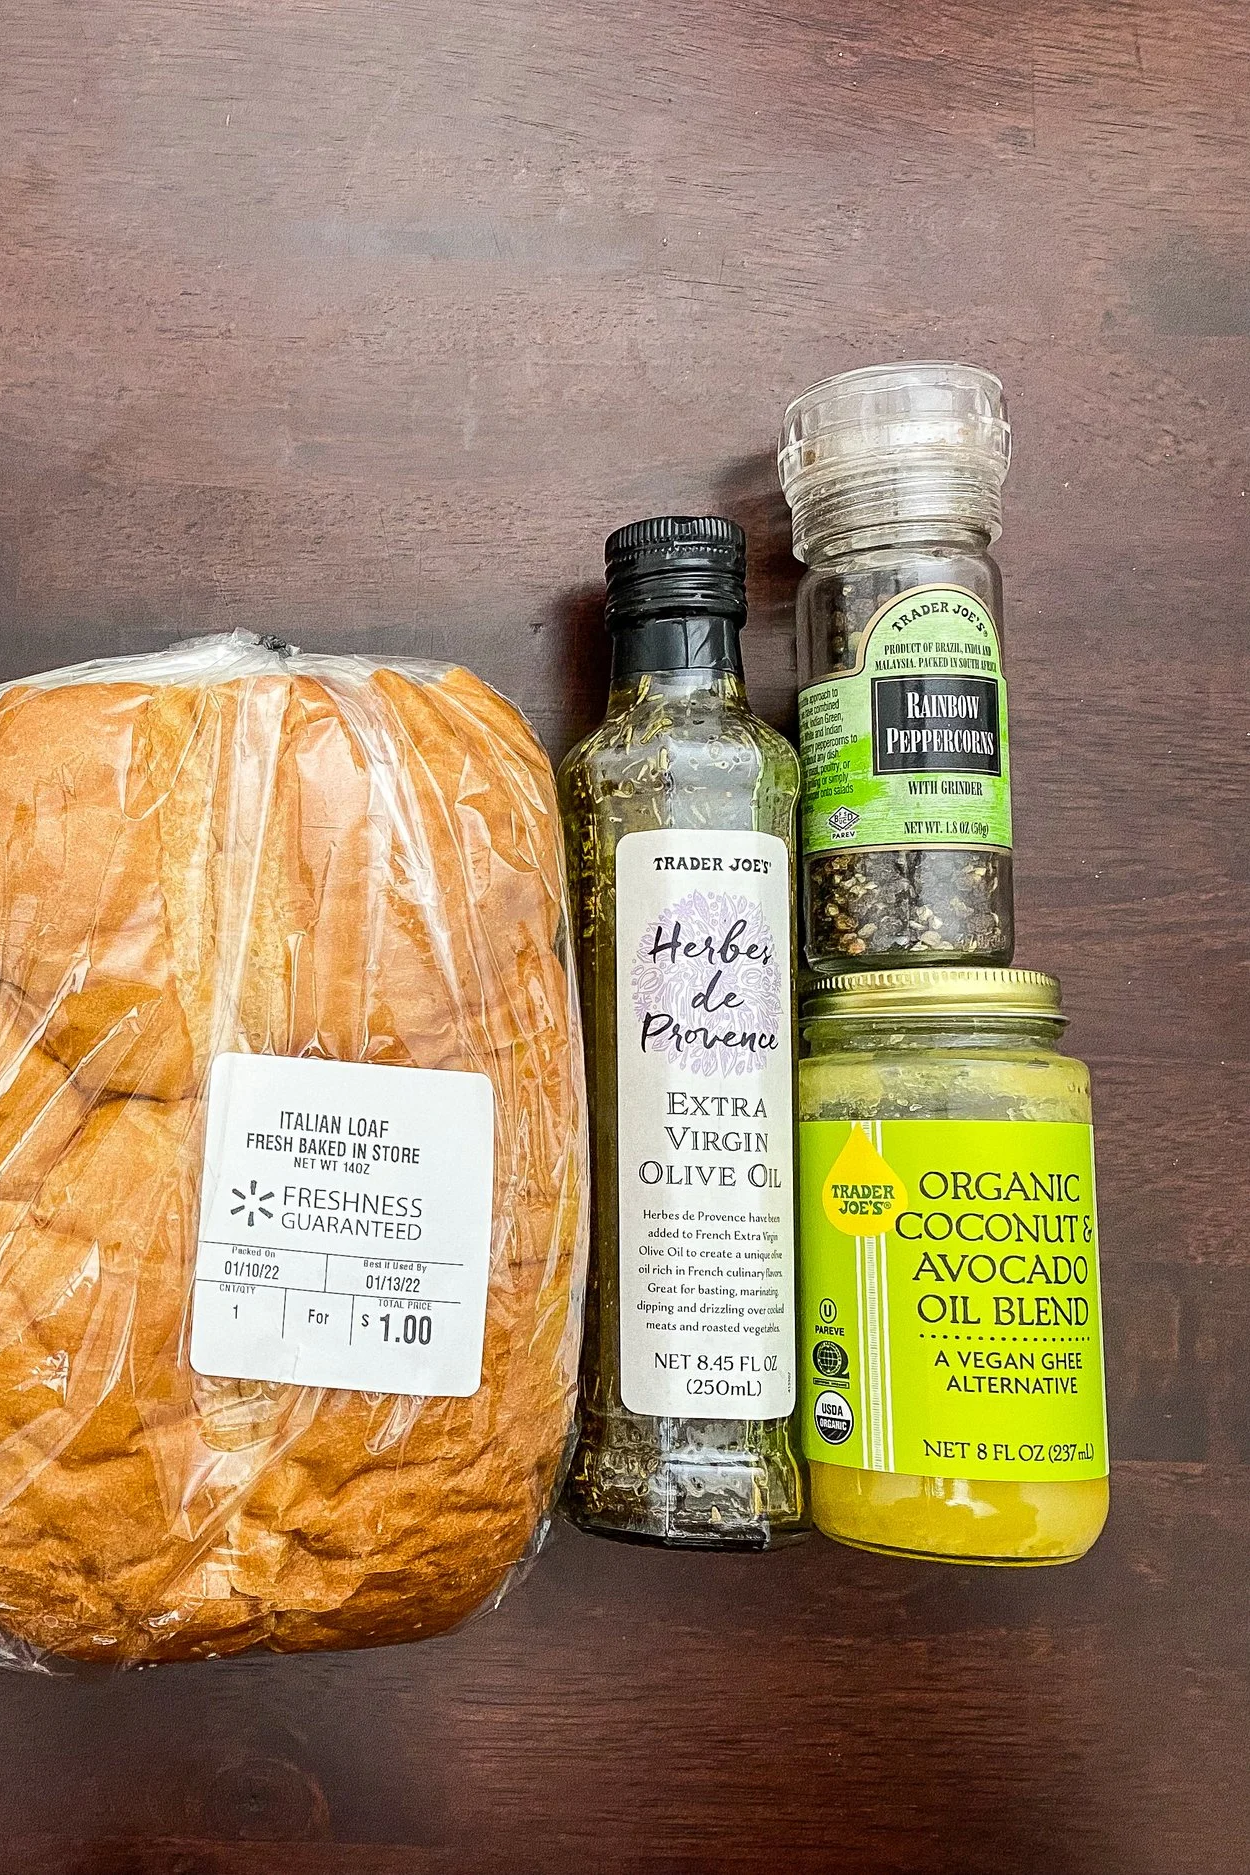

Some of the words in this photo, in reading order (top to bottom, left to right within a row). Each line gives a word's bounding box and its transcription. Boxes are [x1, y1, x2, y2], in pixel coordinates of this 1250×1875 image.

[892, 601, 949, 633] TRADER
[952, 603, 986, 633] JOE'S
[884, 642, 921, 656] PRODUCT
[923, 642, 933, 654] OF
[935, 641, 963, 655] BRAZIL,
[875, 658, 917, 671] MALAYSIA.
[918, 657, 948, 669] PACKED
[906, 691, 980, 720] RAINBOW
[886, 727, 994, 756] PEPPERCORNS
[908, 780, 938, 796] WITH
[940, 780, 983, 796] GRINDER
[945, 822, 958, 834] 1.8
[970, 822, 990, 838] (50g)
[652, 856, 724, 872] TRADER
[728, 857, 770, 874] JOE'S
[647, 918, 772, 966] Herbes
[691, 969, 746, 1012] de
[640, 1012, 779, 1054] Provence
[666, 1091, 768, 1118] EXTRA
[280, 1110, 342, 1135] ITALIAN
[348, 1116, 390, 1138] LOAF
[246, 1132, 294, 1152] FRESH
[298, 1137, 346, 1158] BAKED
[352, 1142, 367, 1160] IN
[372, 1144, 420, 1165] STORE
[664, 1126, 768, 1153] VIRGIN
[294, 1157, 317, 1170] NET
[320, 1160, 338, 1172] WT
[344, 1162, 370, 1175] 14OZ
[638, 1160, 737, 1187] OLIVE
[747, 1163, 782, 1189] OIL
[832, 1184, 895, 1200] TRADER
[918, 1170, 1080, 1202] ORGANIC
[282, 1186, 423, 1218] FRESHNESS
[838, 1200, 884, 1216] JOE'S
[642, 1209, 680, 1221] Herbes
[682, 1210, 696, 1221] de
[697, 1210, 746, 1222] Provence
[280, 1212, 422, 1241] GUARANTEED
[895, 1212, 1078, 1244] COCONUT
[232, 1246, 262, 1258] Packed
[264, 1249, 276, 1258] On
[224, 1260, 280, 1280] 01/10/22
[363, 1260, 382, 1270] Best
[384, 1261, 391, 1270] If
[392, 1262, 414, 1272] Used
[416, 1264, 428, 1274] By
[912, 1250, 1088, 1285] AVOCADO
[219, 1284, 256, 1296] CNT/QTY
[365, 1274, 421, 1294] 01/13/22
[378, 1299, 405, 1310] TOTAL
[406, 1300, 432, 1311] PRICE
[917, 1294, 980, 1325] OIL
[994, 1296, 1090, 1327] BLEND
[308, 1308, 330, 1326] For
[379, 1312, 432, 1346] 1.00
[814, 1324, 845, 1336] PAREVE
[654, 1352, 692, 1370] NET
[696, 1354, 734, 1372] 8.45
[740, 1356, 761, 1372] FL
[764, 1355, 778, 1372] OZ
[934, 1350, 950, 1367] A
[957, 1351, 1034, 1370] VEGAN
[1040, 1352, 1082, 1371] GHEE
[686, 1378, 762, 1398] (250mL)
[946, 1374, 1078, 1395] ALTERNATIVE
[821, 1402, 844, 1417] USDA
[819, 1418, 848, 1431] ORGANIC
[922, 1440, 970, 1460] NET
[977, 1442, 987, 1460] 8
[993, 1444, 1015, 1462] FL
[1018, 1444, 1046, 1462] OZ
[1048, 1443, 1076, 1464] (237
